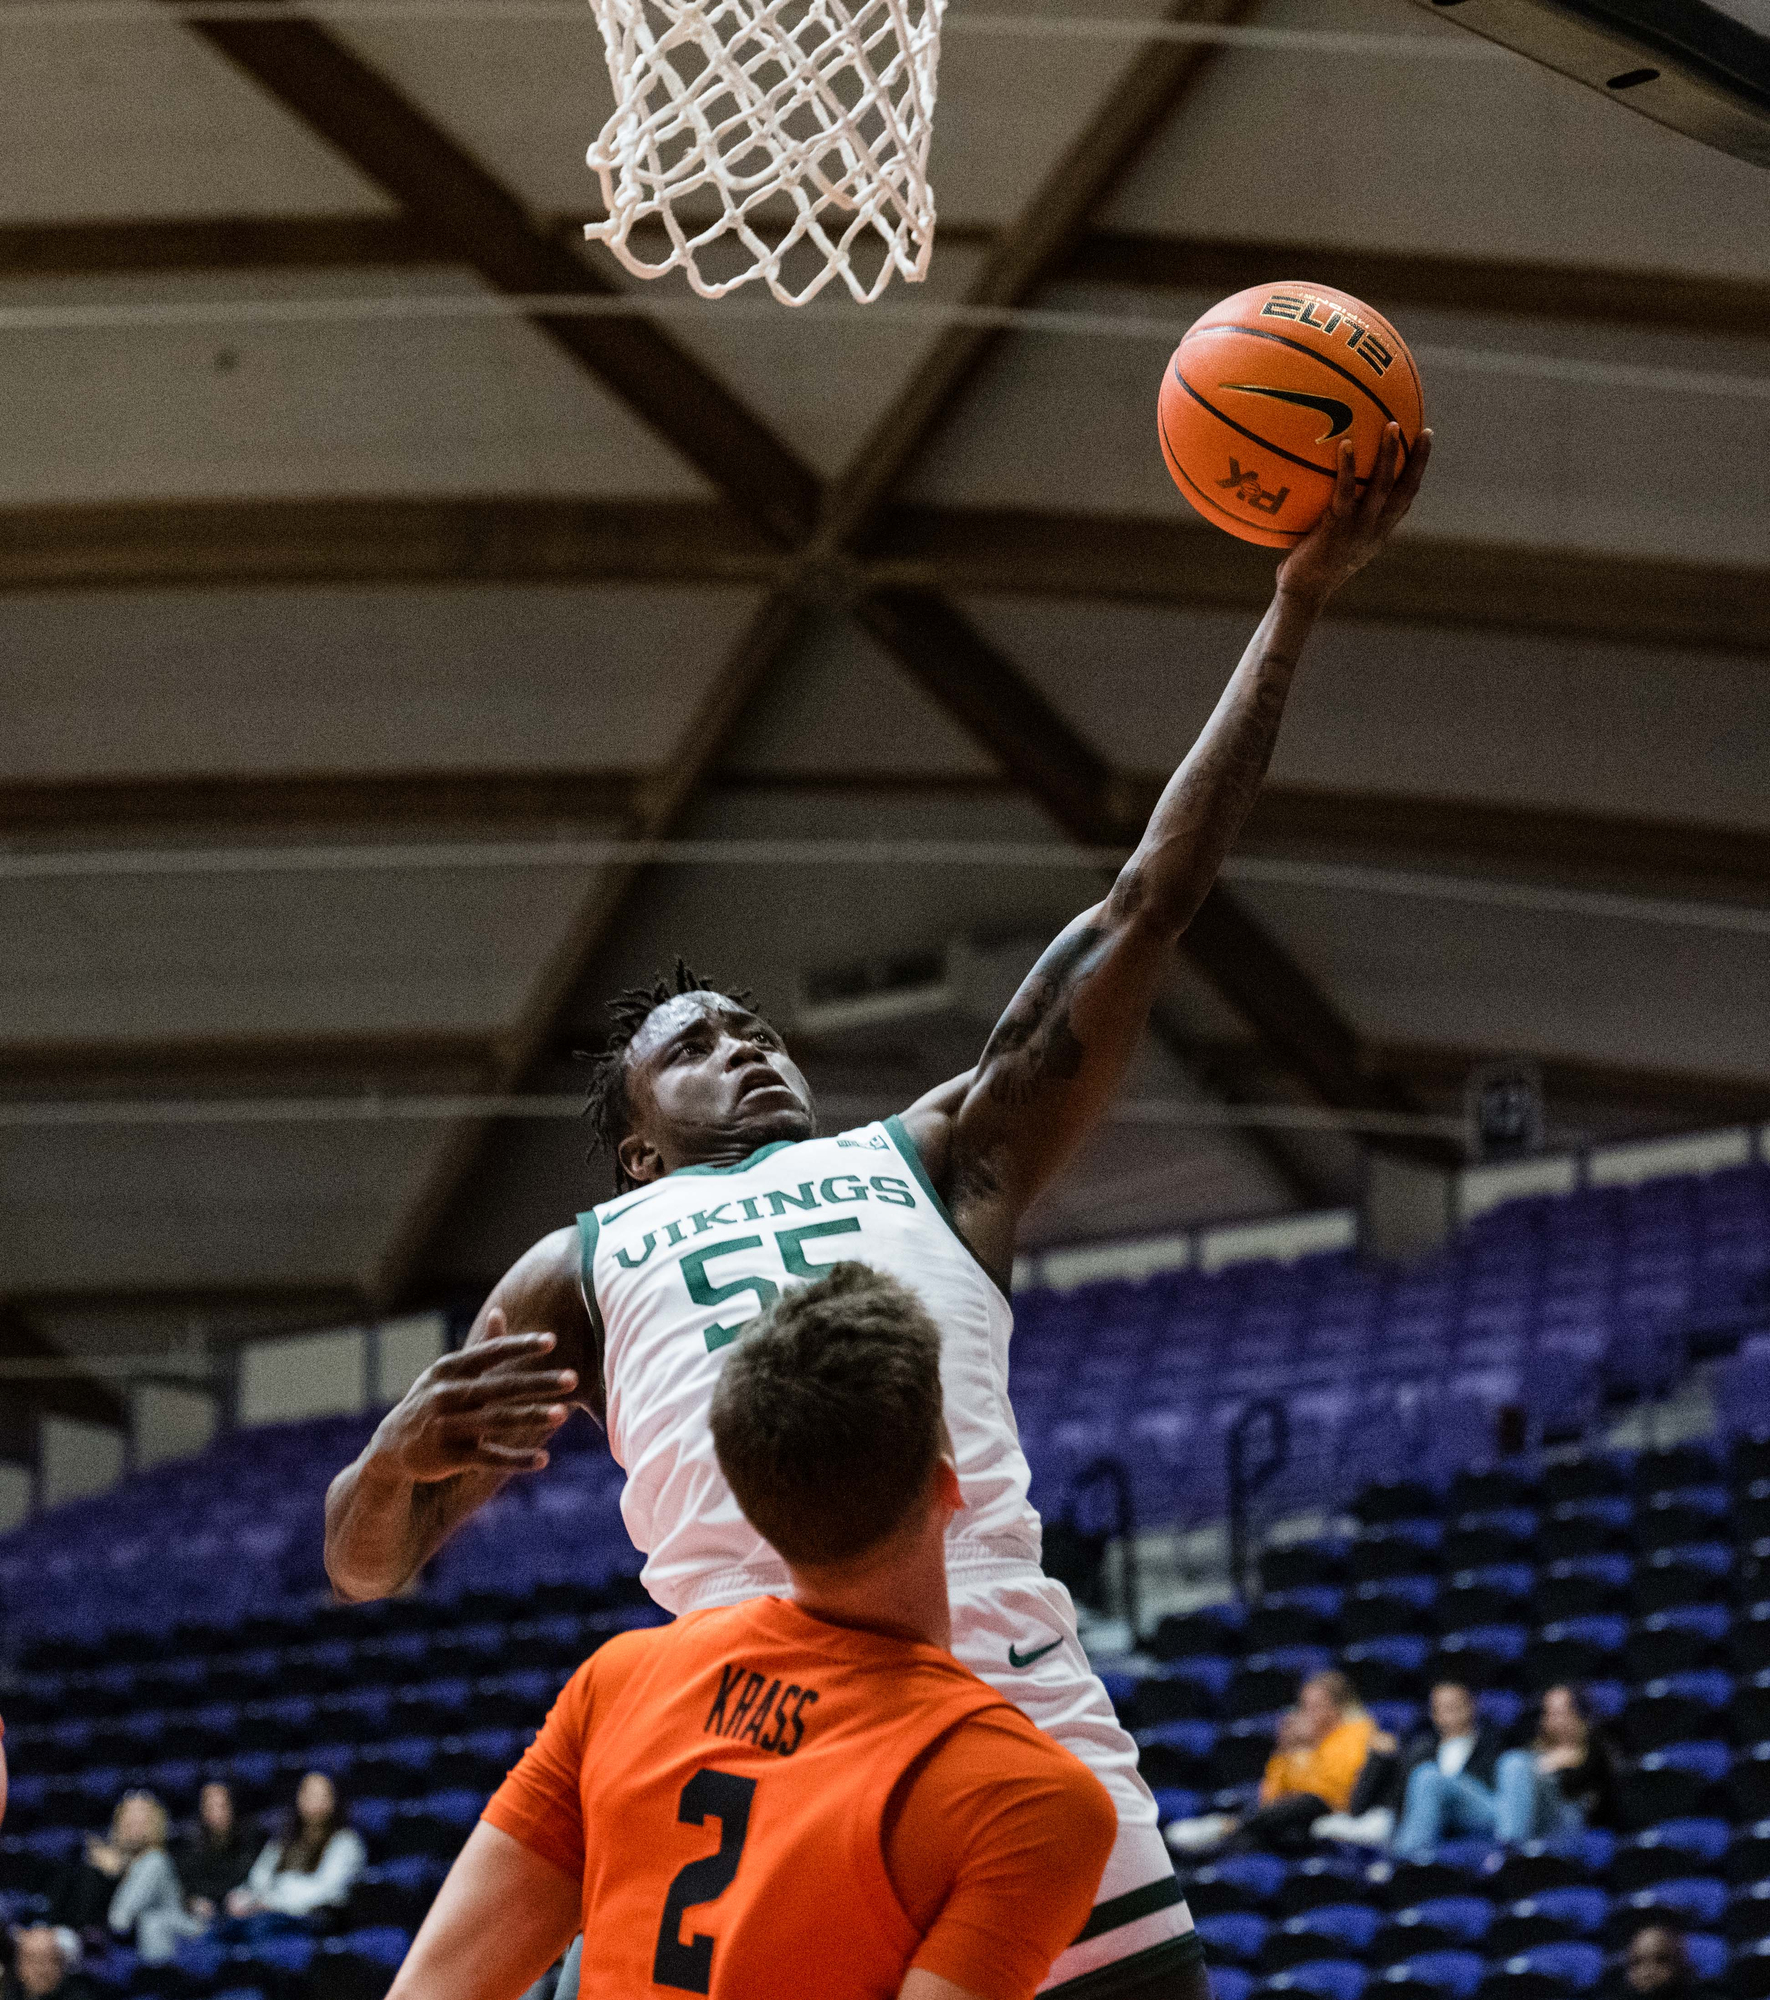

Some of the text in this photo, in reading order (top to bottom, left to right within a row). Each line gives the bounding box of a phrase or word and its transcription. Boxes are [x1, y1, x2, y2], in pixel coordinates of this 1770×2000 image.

[1260, 295, 1395, 378] ELITE
[611, 1175, 916, 1269] VIKINGS
[704, 1664, 819, 1757] KRASS
[653, 1767, 759, 1996] 2
